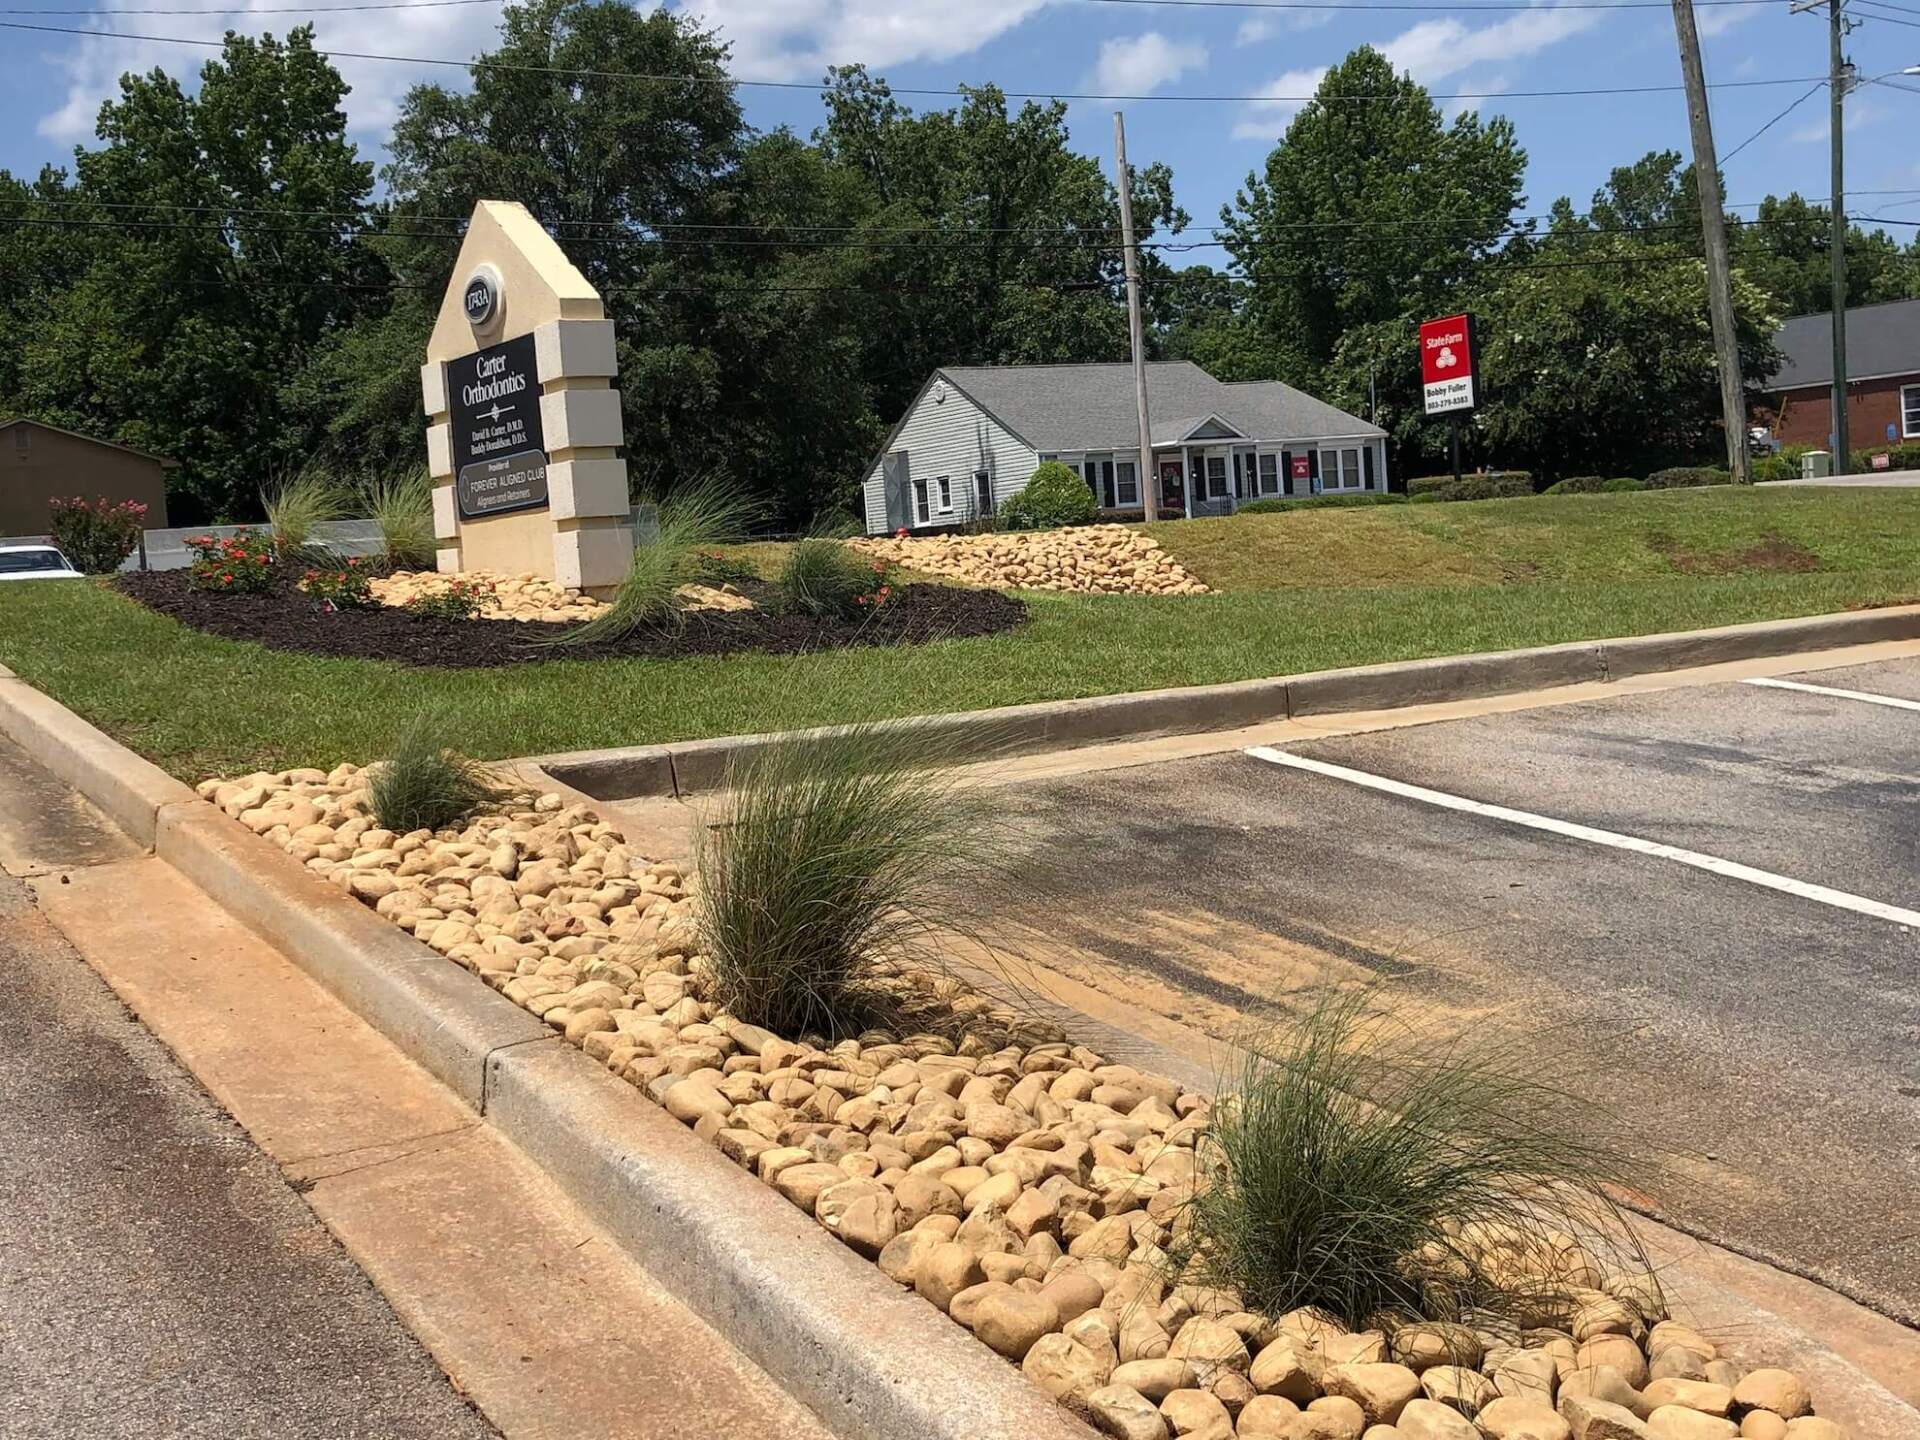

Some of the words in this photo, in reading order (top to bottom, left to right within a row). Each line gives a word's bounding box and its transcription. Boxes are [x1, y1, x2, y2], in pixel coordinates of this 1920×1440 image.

[467, 287, 489, 311] 1743A
[476, 355, 506, 379] Carter
[463, 371, 526, 407] Orthodontics
[1426, 387, 1446, 397] Bobby
[1447, 383, 1467, 394] Fuller
[470, 477, 498, 493] FOREVER
[499, 471, 526, 487] ALIGNED
[527, 466, 545, 481] CLUB
